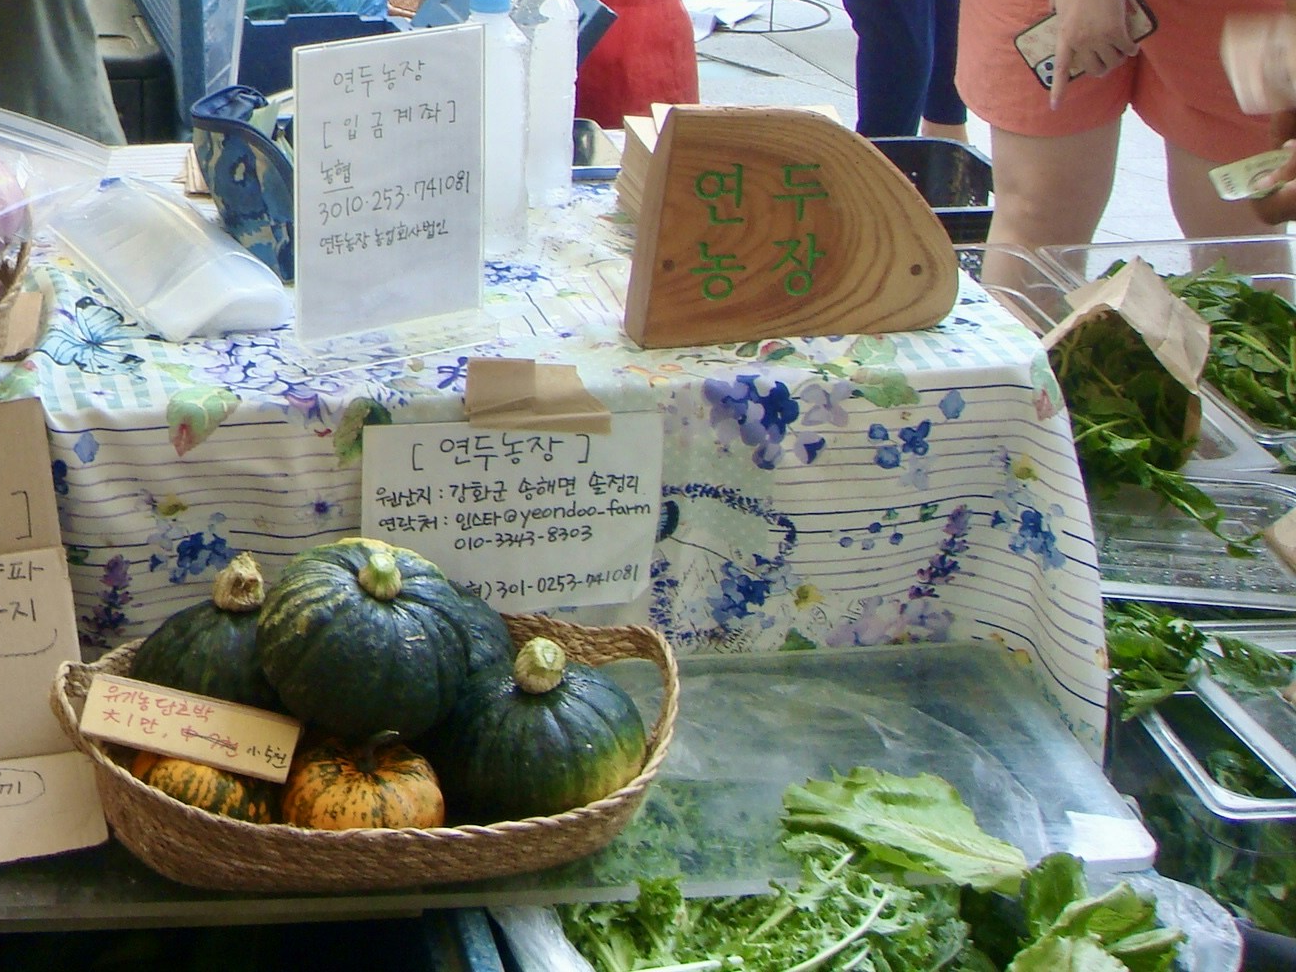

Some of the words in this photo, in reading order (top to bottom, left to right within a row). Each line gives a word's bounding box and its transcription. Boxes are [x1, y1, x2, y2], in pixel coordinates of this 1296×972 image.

[333, 59, 426, 98] 연두농장
[320, 159, 352, 185] 농협
[319, 230, 370, 255] 연두농장
[449, 479, 507, 504] 강화군
[518, 475, 577, 502] 송해면
[454, 525, 593, 550] 010-3343-8303
[103, 684, 150, 712] 유기농
